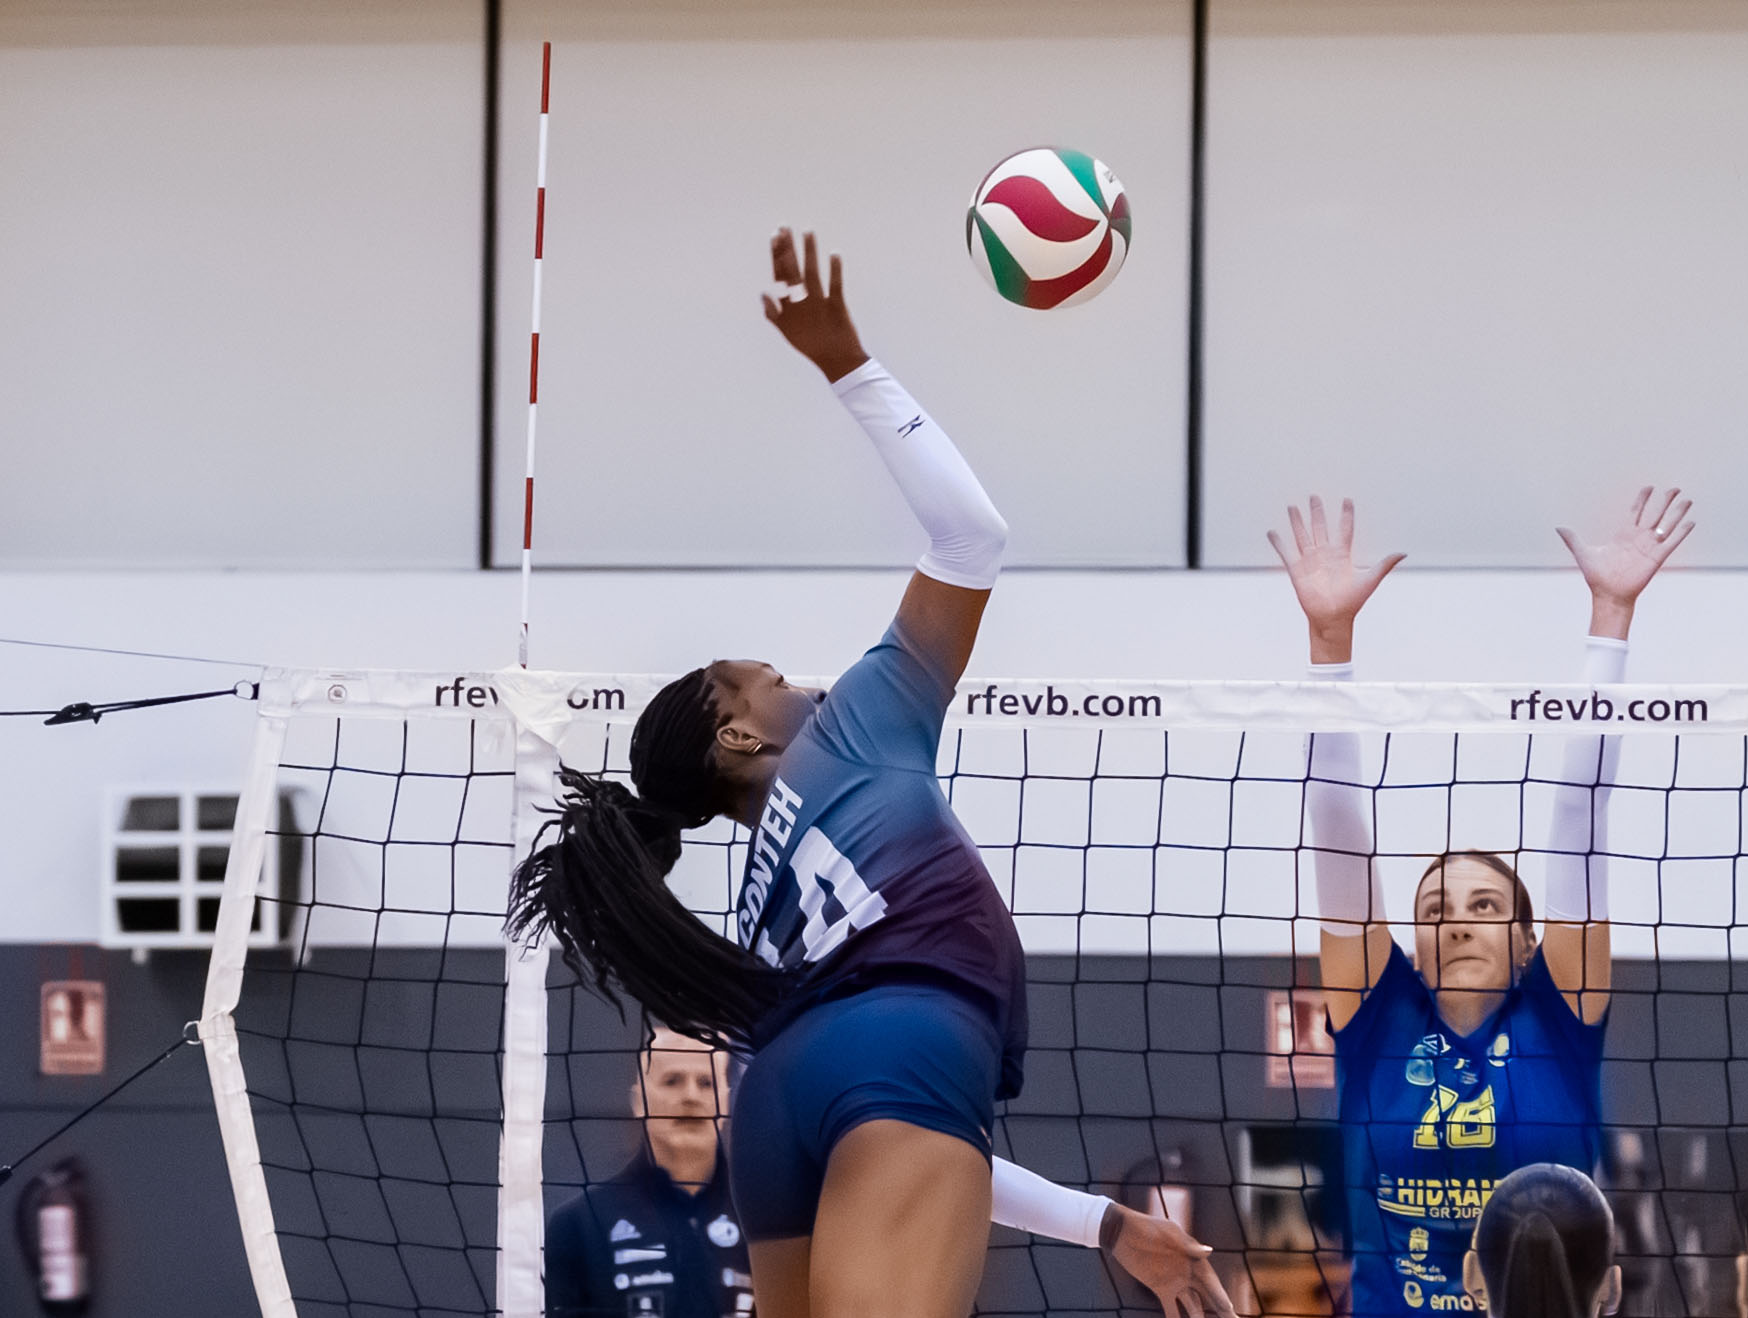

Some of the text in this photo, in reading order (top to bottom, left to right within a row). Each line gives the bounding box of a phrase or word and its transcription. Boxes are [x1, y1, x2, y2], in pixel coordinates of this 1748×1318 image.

[967, 685, 1161, 717] rfevb.com
[1510, 690, 1708, 722] rfevb.com
[738, 776, 803, 950] CONTEH
